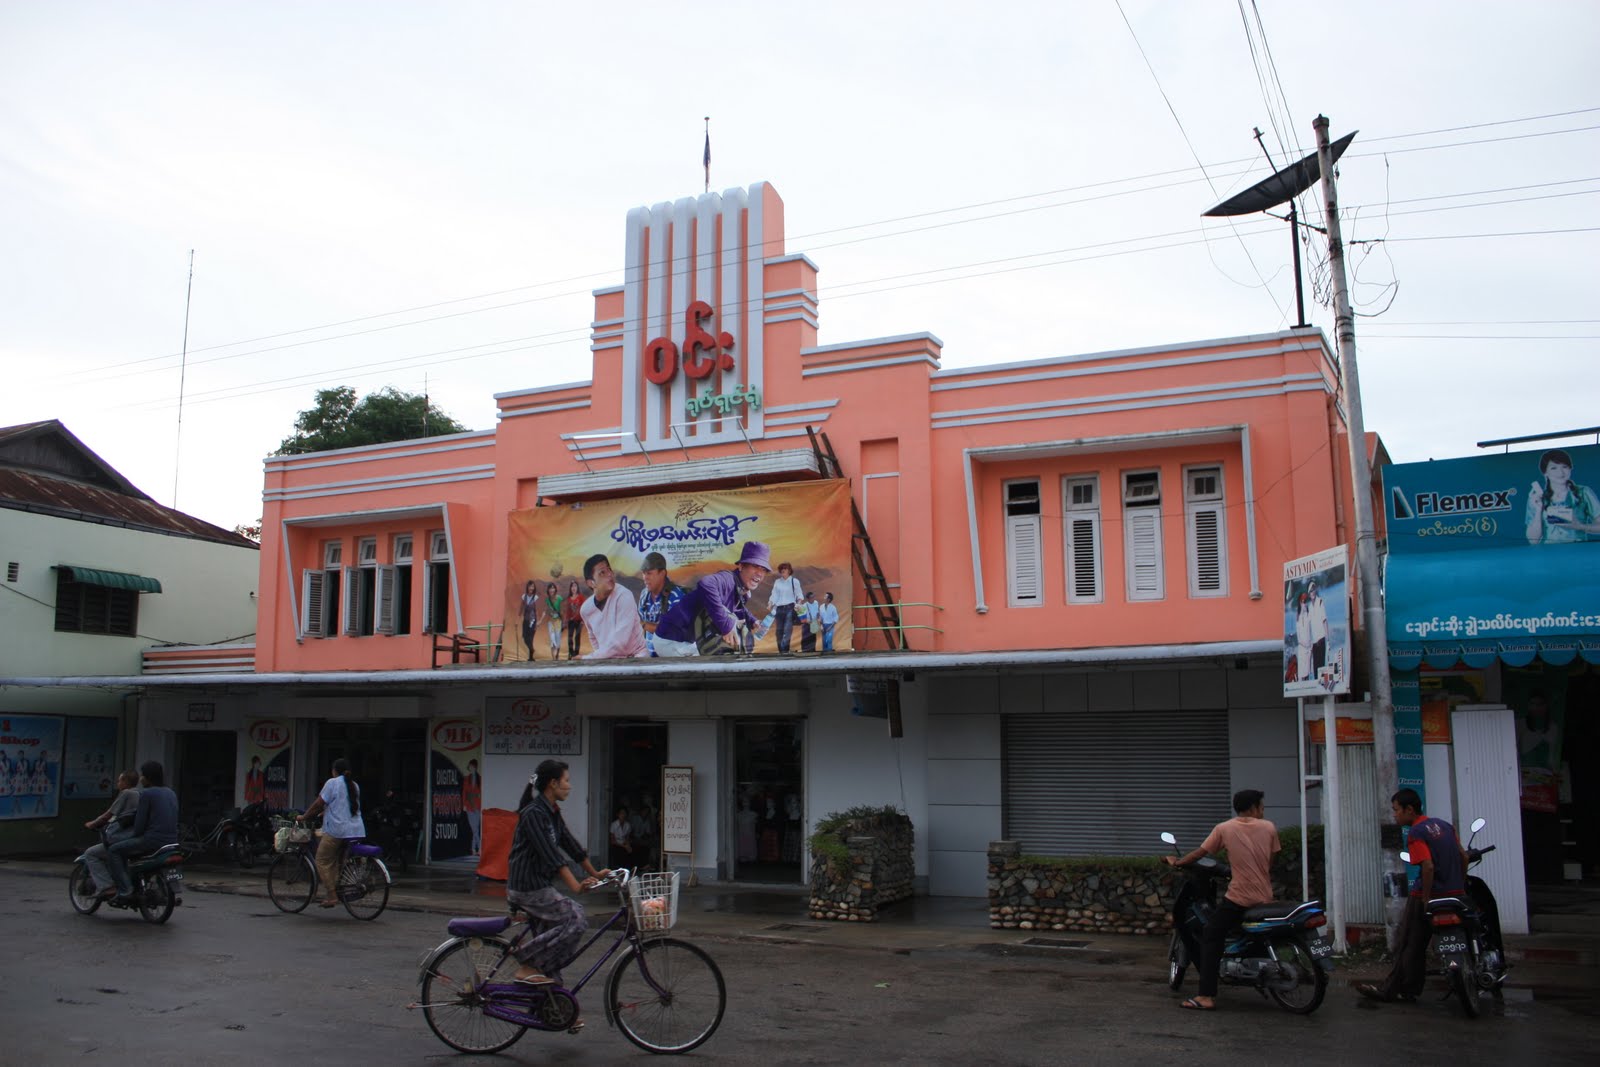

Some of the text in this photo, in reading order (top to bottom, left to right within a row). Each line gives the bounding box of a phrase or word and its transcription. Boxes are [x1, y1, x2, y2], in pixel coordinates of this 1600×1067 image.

[1416, 489, 1513, 515] Flemex
[1285, 559, 1317, 579] ASTYMIN
[436, 768, 459, 785] DIGITAL
[432, 793, 462, 816] PHOTO
[434, 823, 459, 840] STUDIO
